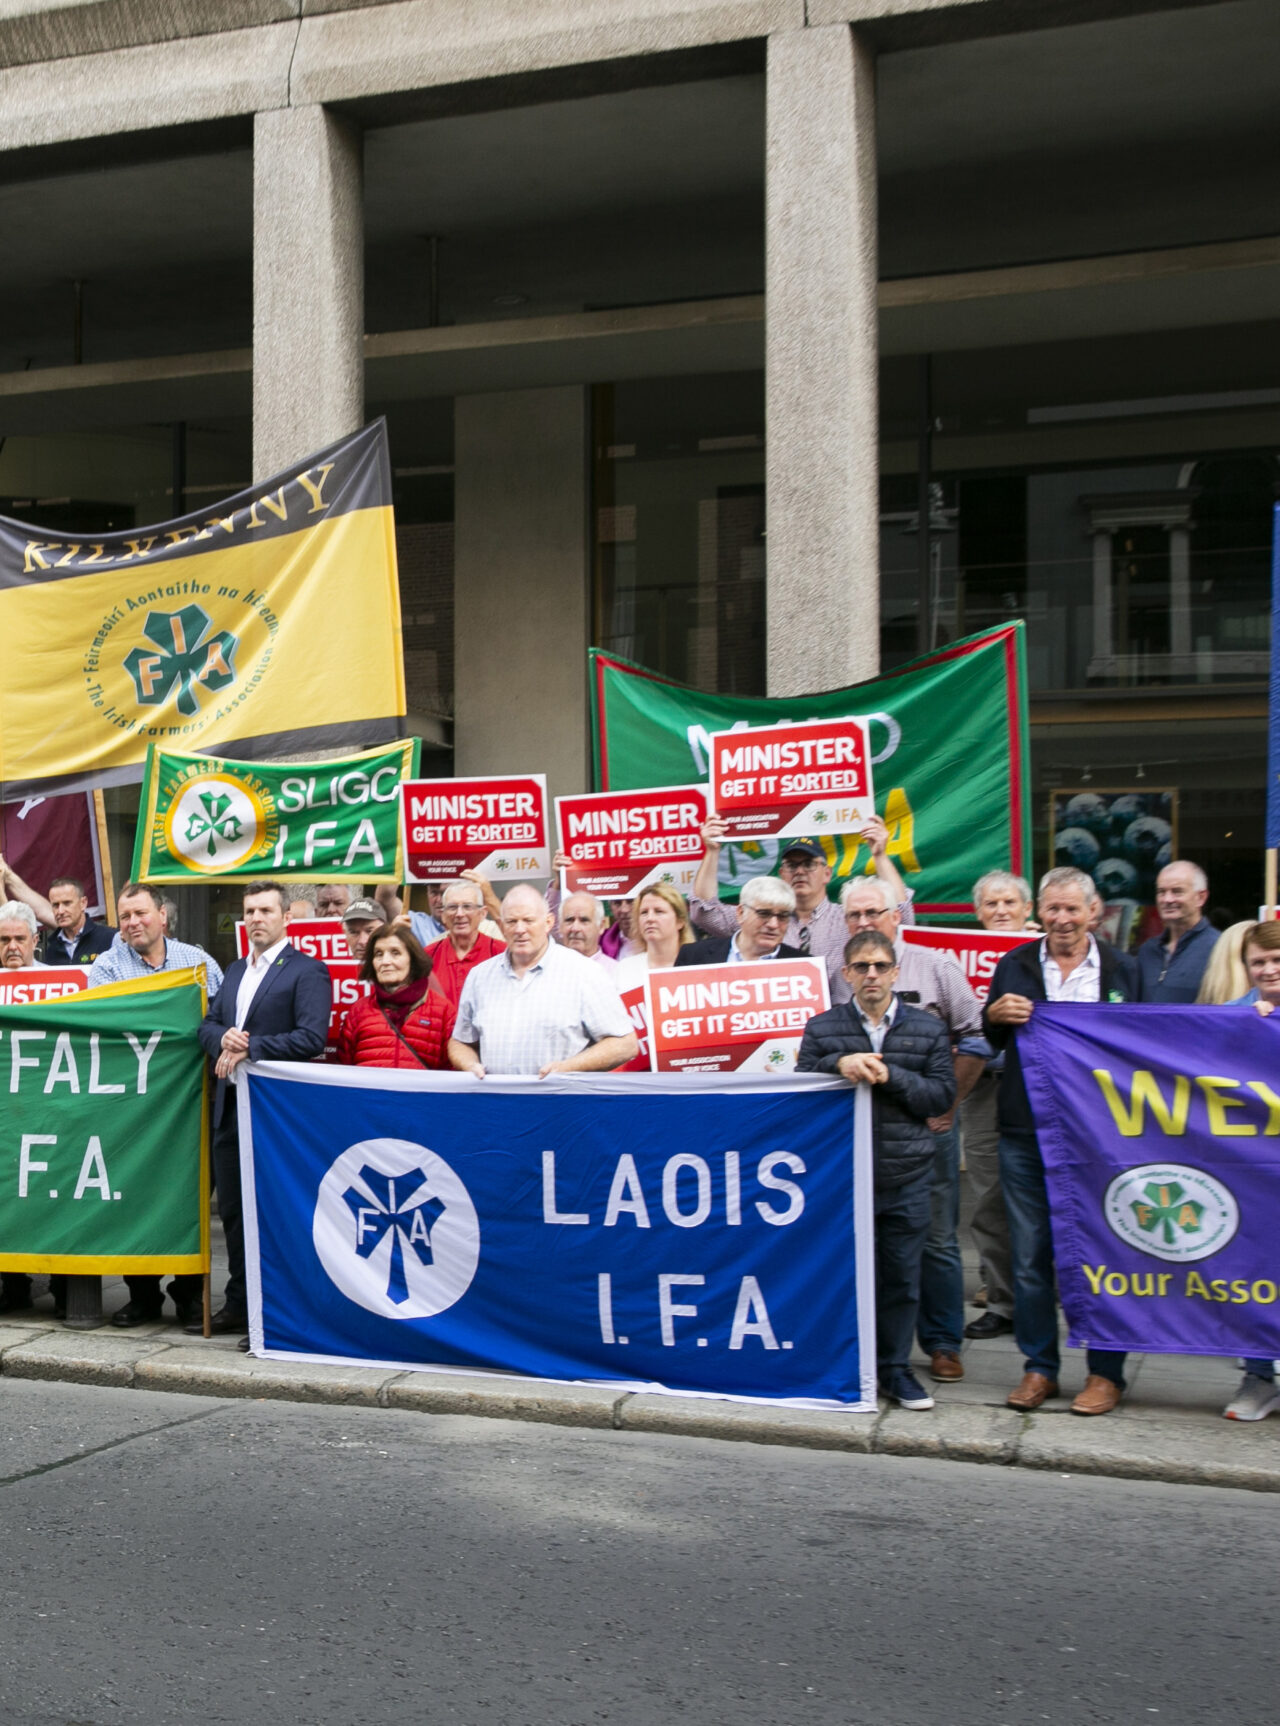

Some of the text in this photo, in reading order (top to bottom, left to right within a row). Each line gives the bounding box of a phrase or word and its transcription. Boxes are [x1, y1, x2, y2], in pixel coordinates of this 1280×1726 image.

[125, 579, 211, 612] Aontaithe
[217, 586, 239, 599] na
[87, 683, 104, 707] The
[216, 646, 273, 721] Association
[721, 736, 861, 775] MINISTER,
[720, 769, 858, 798] GET IT SORTED
[153, 812, 167, 853] IRISH
[242, 773, 279, 858] ASSOCIATION
[411, 792, 540, 821] MINISTER,
[835, 808, 862, 823] IFA
[412, 822, 536, 843] GET IT SORTED
[571, 834, 701, 860] GET IT SORTED
[515, 857, 539, 870] IFA
[681, 870, 695, 884] IF
[659, 975, 819, 1013] MINISTER,
[661, 1017, 703, 1038] GET
[707, 1015, 727, 1034] IT
[542, 1150, 806, 1228] LAOIS
[1082, 1265, 1280, 1304] Your Asso
